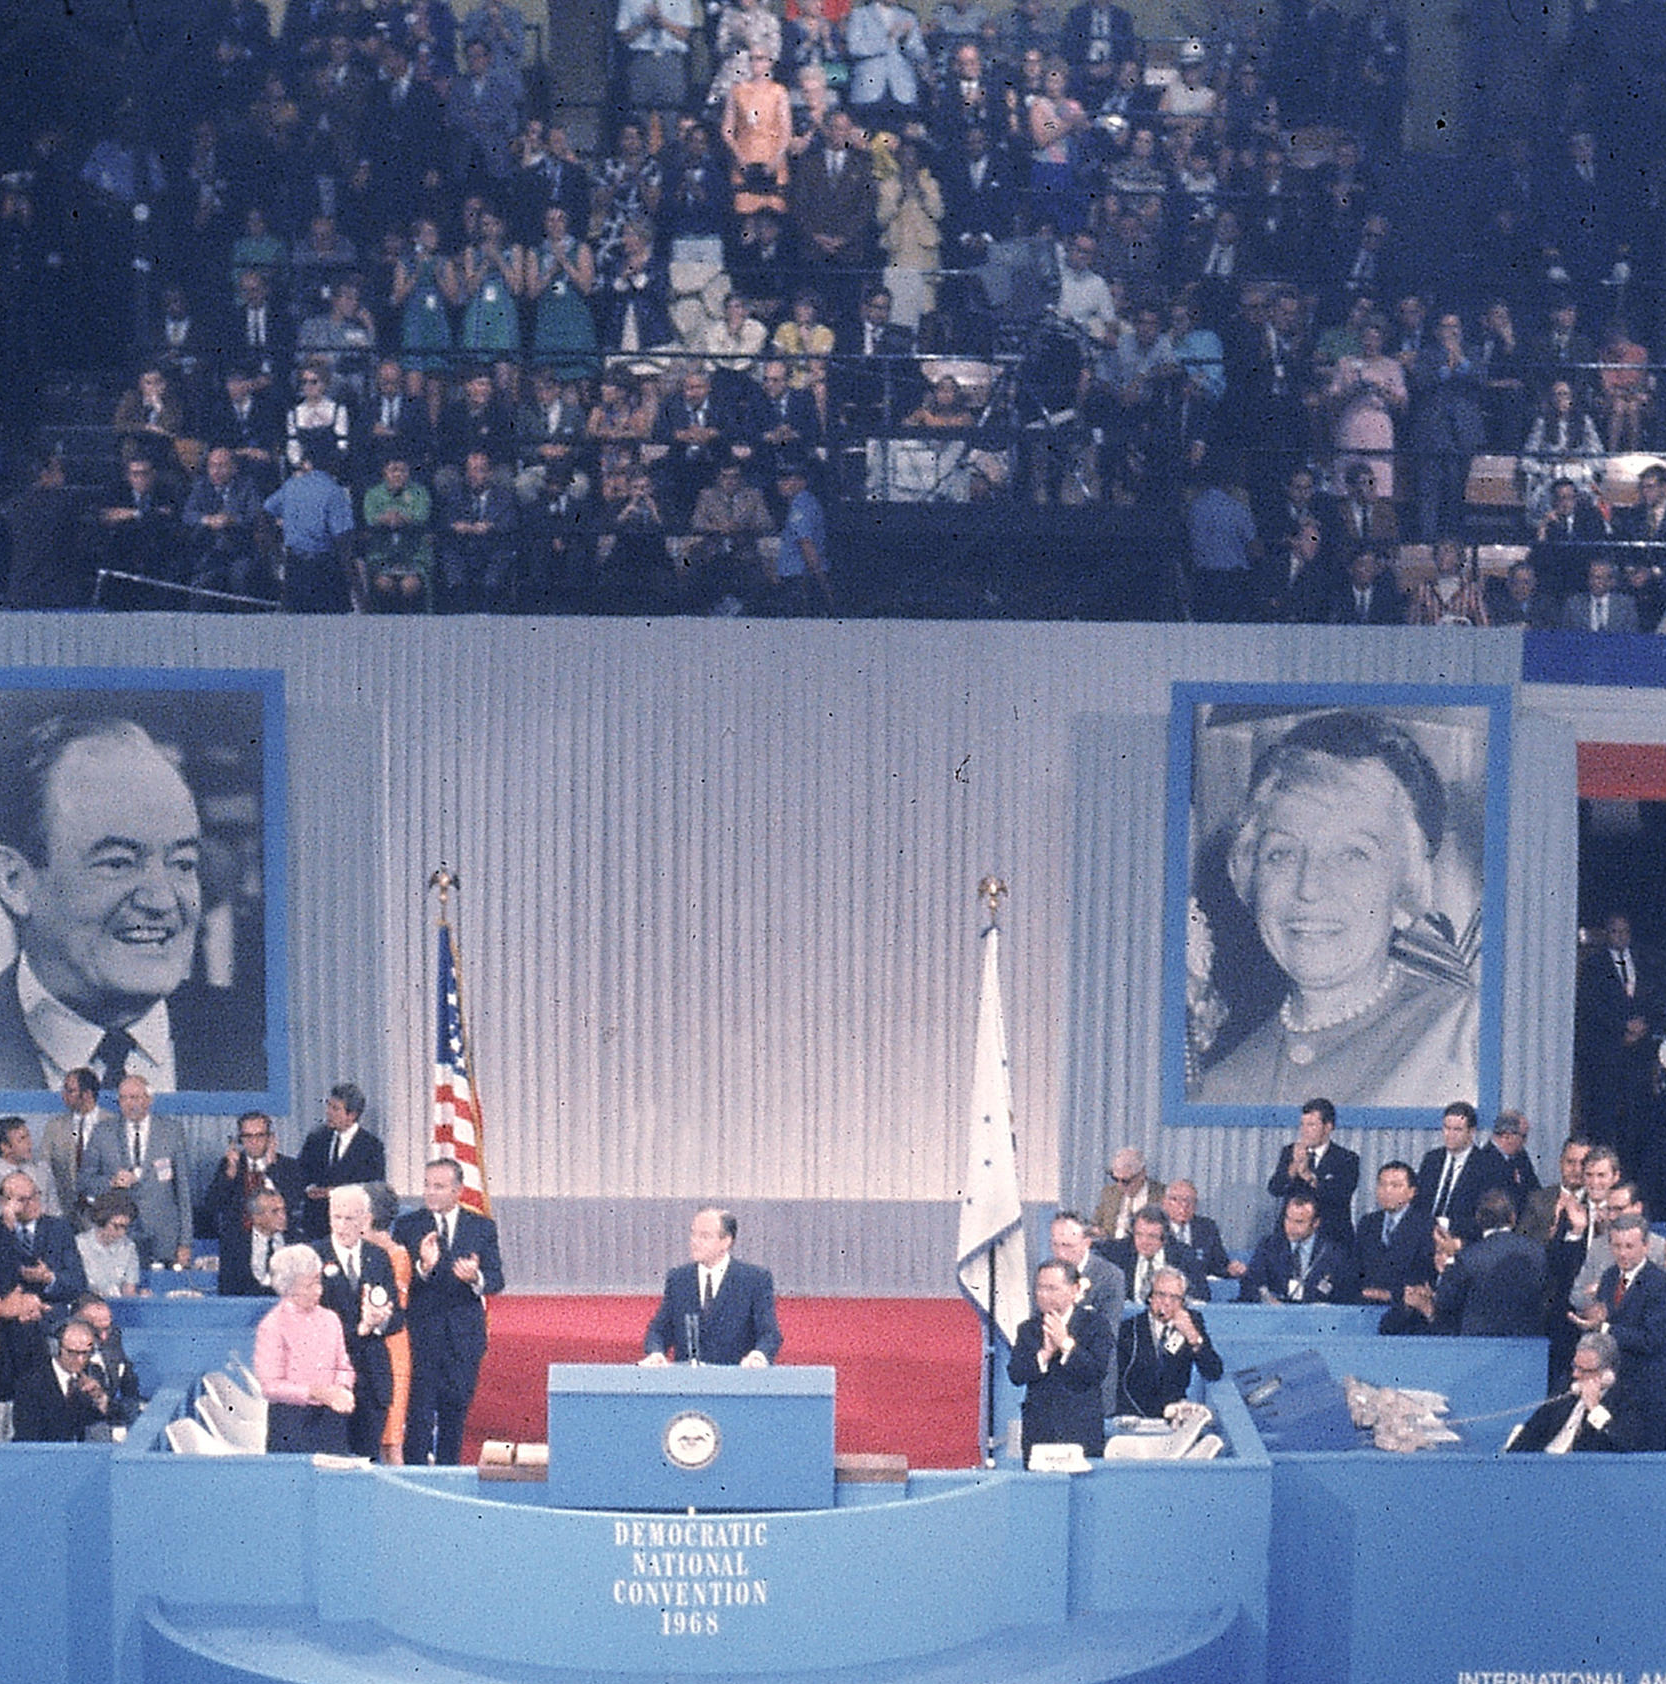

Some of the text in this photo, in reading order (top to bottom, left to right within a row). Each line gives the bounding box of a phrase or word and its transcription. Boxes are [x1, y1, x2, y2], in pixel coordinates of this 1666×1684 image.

[614, 1521, 768, 1547] DEMOCRATIC
[633, 1551, 750, 1577] NATIONAL
[613, 1579, 768, 1606] CONVENTION
[662, 1611, 719, 1636] 1968
